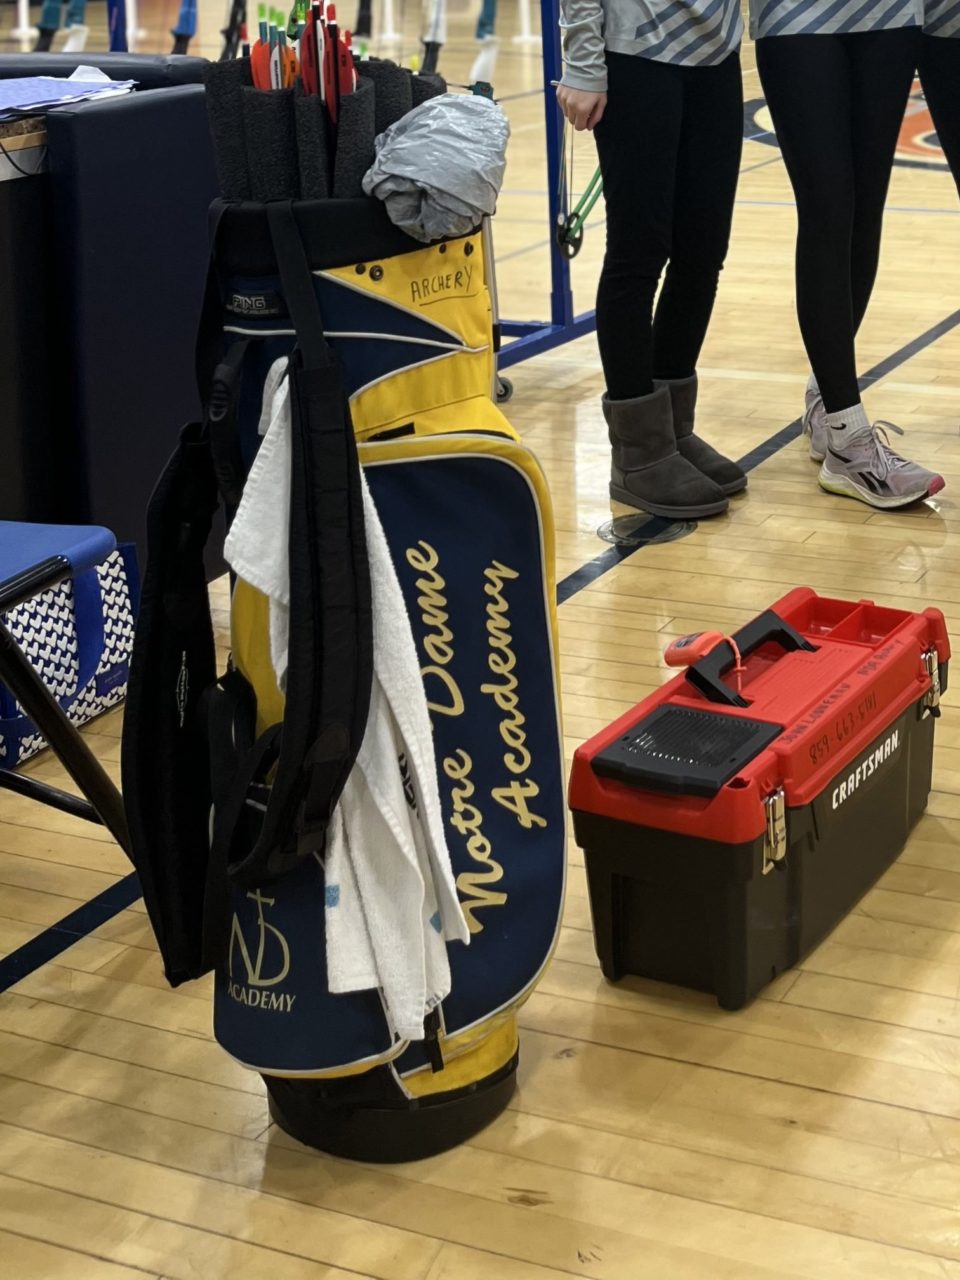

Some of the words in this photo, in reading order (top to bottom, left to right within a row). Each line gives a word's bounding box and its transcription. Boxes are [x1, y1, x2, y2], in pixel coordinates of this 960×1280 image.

[232, 294, 266, 310] PING
[410, 264, 473, 303] ARCHERY
[405, 539, 465, 720] Dame
[479, 559, 546, 830] Academy
[831, 728, 899, 810] CRAFTSMAN
[442, 748, 508, 934] Notre
[227, 979, 297, 1013] ACADEMY
